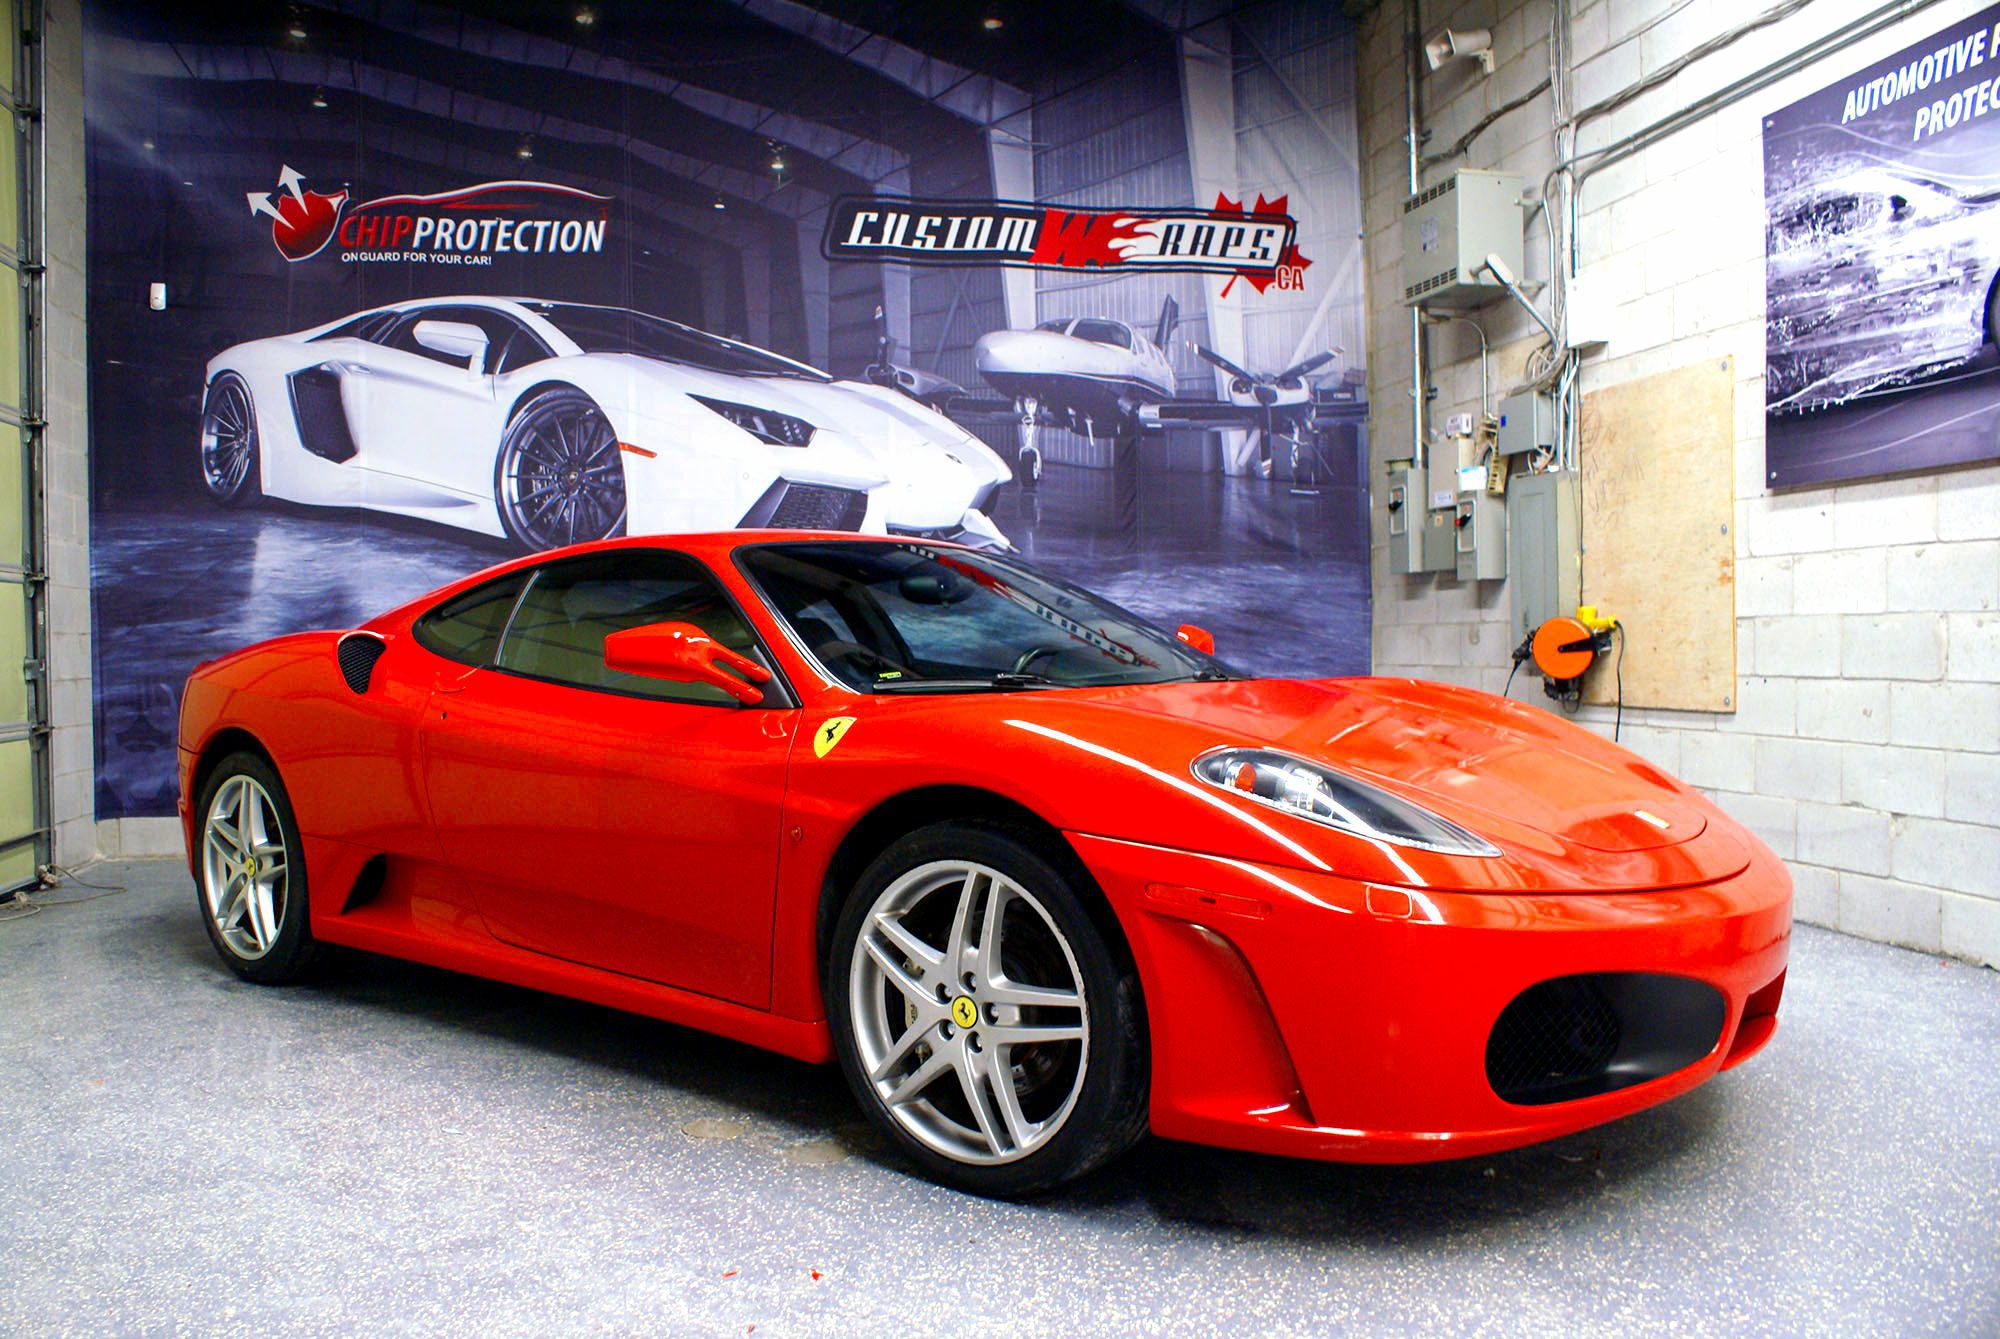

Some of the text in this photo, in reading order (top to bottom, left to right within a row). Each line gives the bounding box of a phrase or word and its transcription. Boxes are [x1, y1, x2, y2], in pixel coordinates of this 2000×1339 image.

[1841, 29, 1988, 125] AUTOMOTIVE
[840, 211, 1037, 253] CUSTOM
[359, 251, 401, 263] GUARD
[403, 251, 427, 263] FOR
[429, 253, 462, 265] YOUR
[464, 255, 492, 266] CAR!
